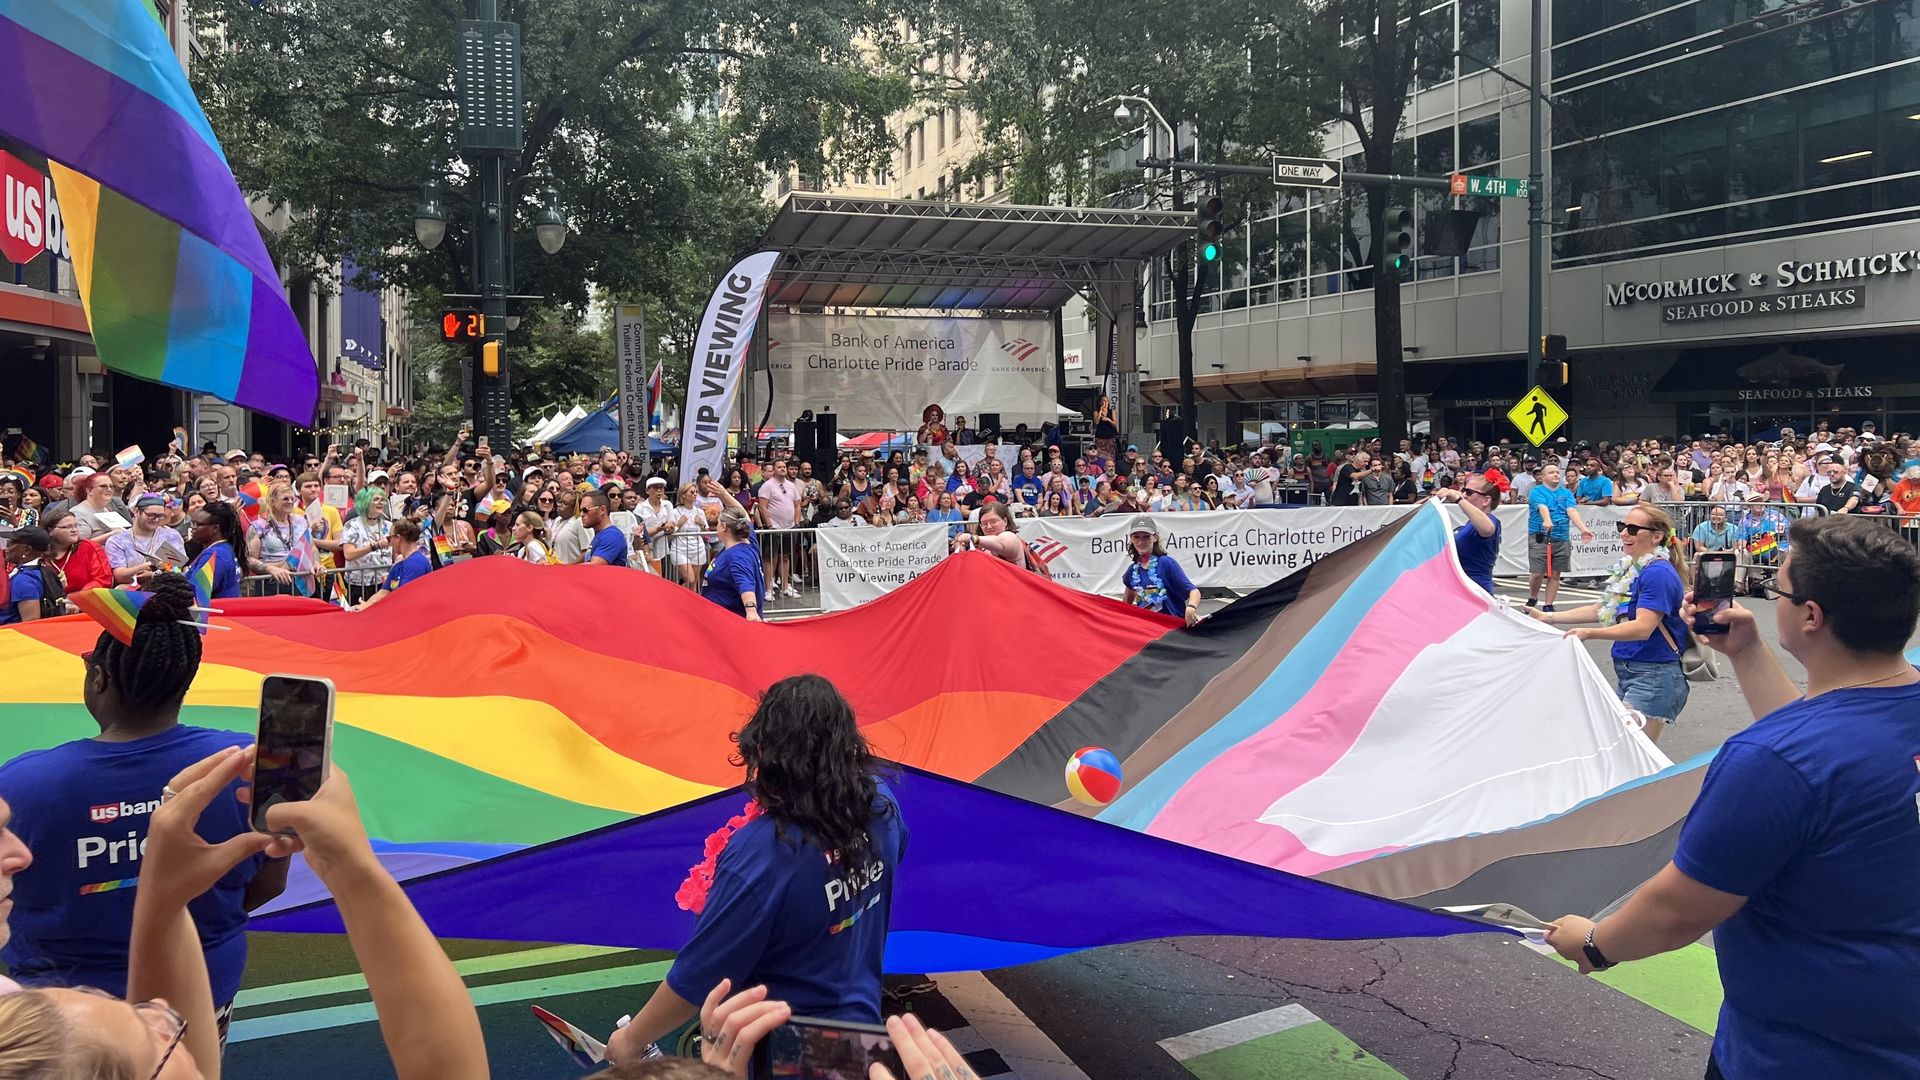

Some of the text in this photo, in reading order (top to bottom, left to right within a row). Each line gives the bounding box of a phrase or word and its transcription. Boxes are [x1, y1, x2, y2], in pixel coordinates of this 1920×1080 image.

[1281, 166, 1320, 177] ONE WAY
[1470, 179, 1528, 194] W. 4TH ST
[1516, 188, 1528, 198] 100
[1748, 272, 1763, 287] &
[1666, 289, 1856, 321] SEAFOOD & STEAKS
[633, 322, 644, 375] Community
[831, 333, 955, 350] Bank of America
[693, 272, 752, 453] VIP VIEWING
[808, 354, 978, 372] Charlotte Pride Parade
[623, 323, 636, 451] Truliant Federal Credit Union
[635, 377, 645, 402] Stage
[1738, 388, 1801, 400] SEAFOOD
[1817, 386, 1873, 398] STEAKS
[636, 406, 647, 451] presented
[840, 541, 927, 553] Bank of America
[1166, 531, 1238, 550] America
[1245, 528, 1325, 546] Charlotte
[1576, 544, 1609, 555] Viewing
[826, 554, 942, 568] Charlotte Pride Parade
[1195, 552, 1223, 568] VIP
[1229, 550, 1298, 568] Viewing
[836, 572, 856, 583] VIP
[859, 571, 905, 584] Viewing
[1050, 572, 1082, 580] MERICA
